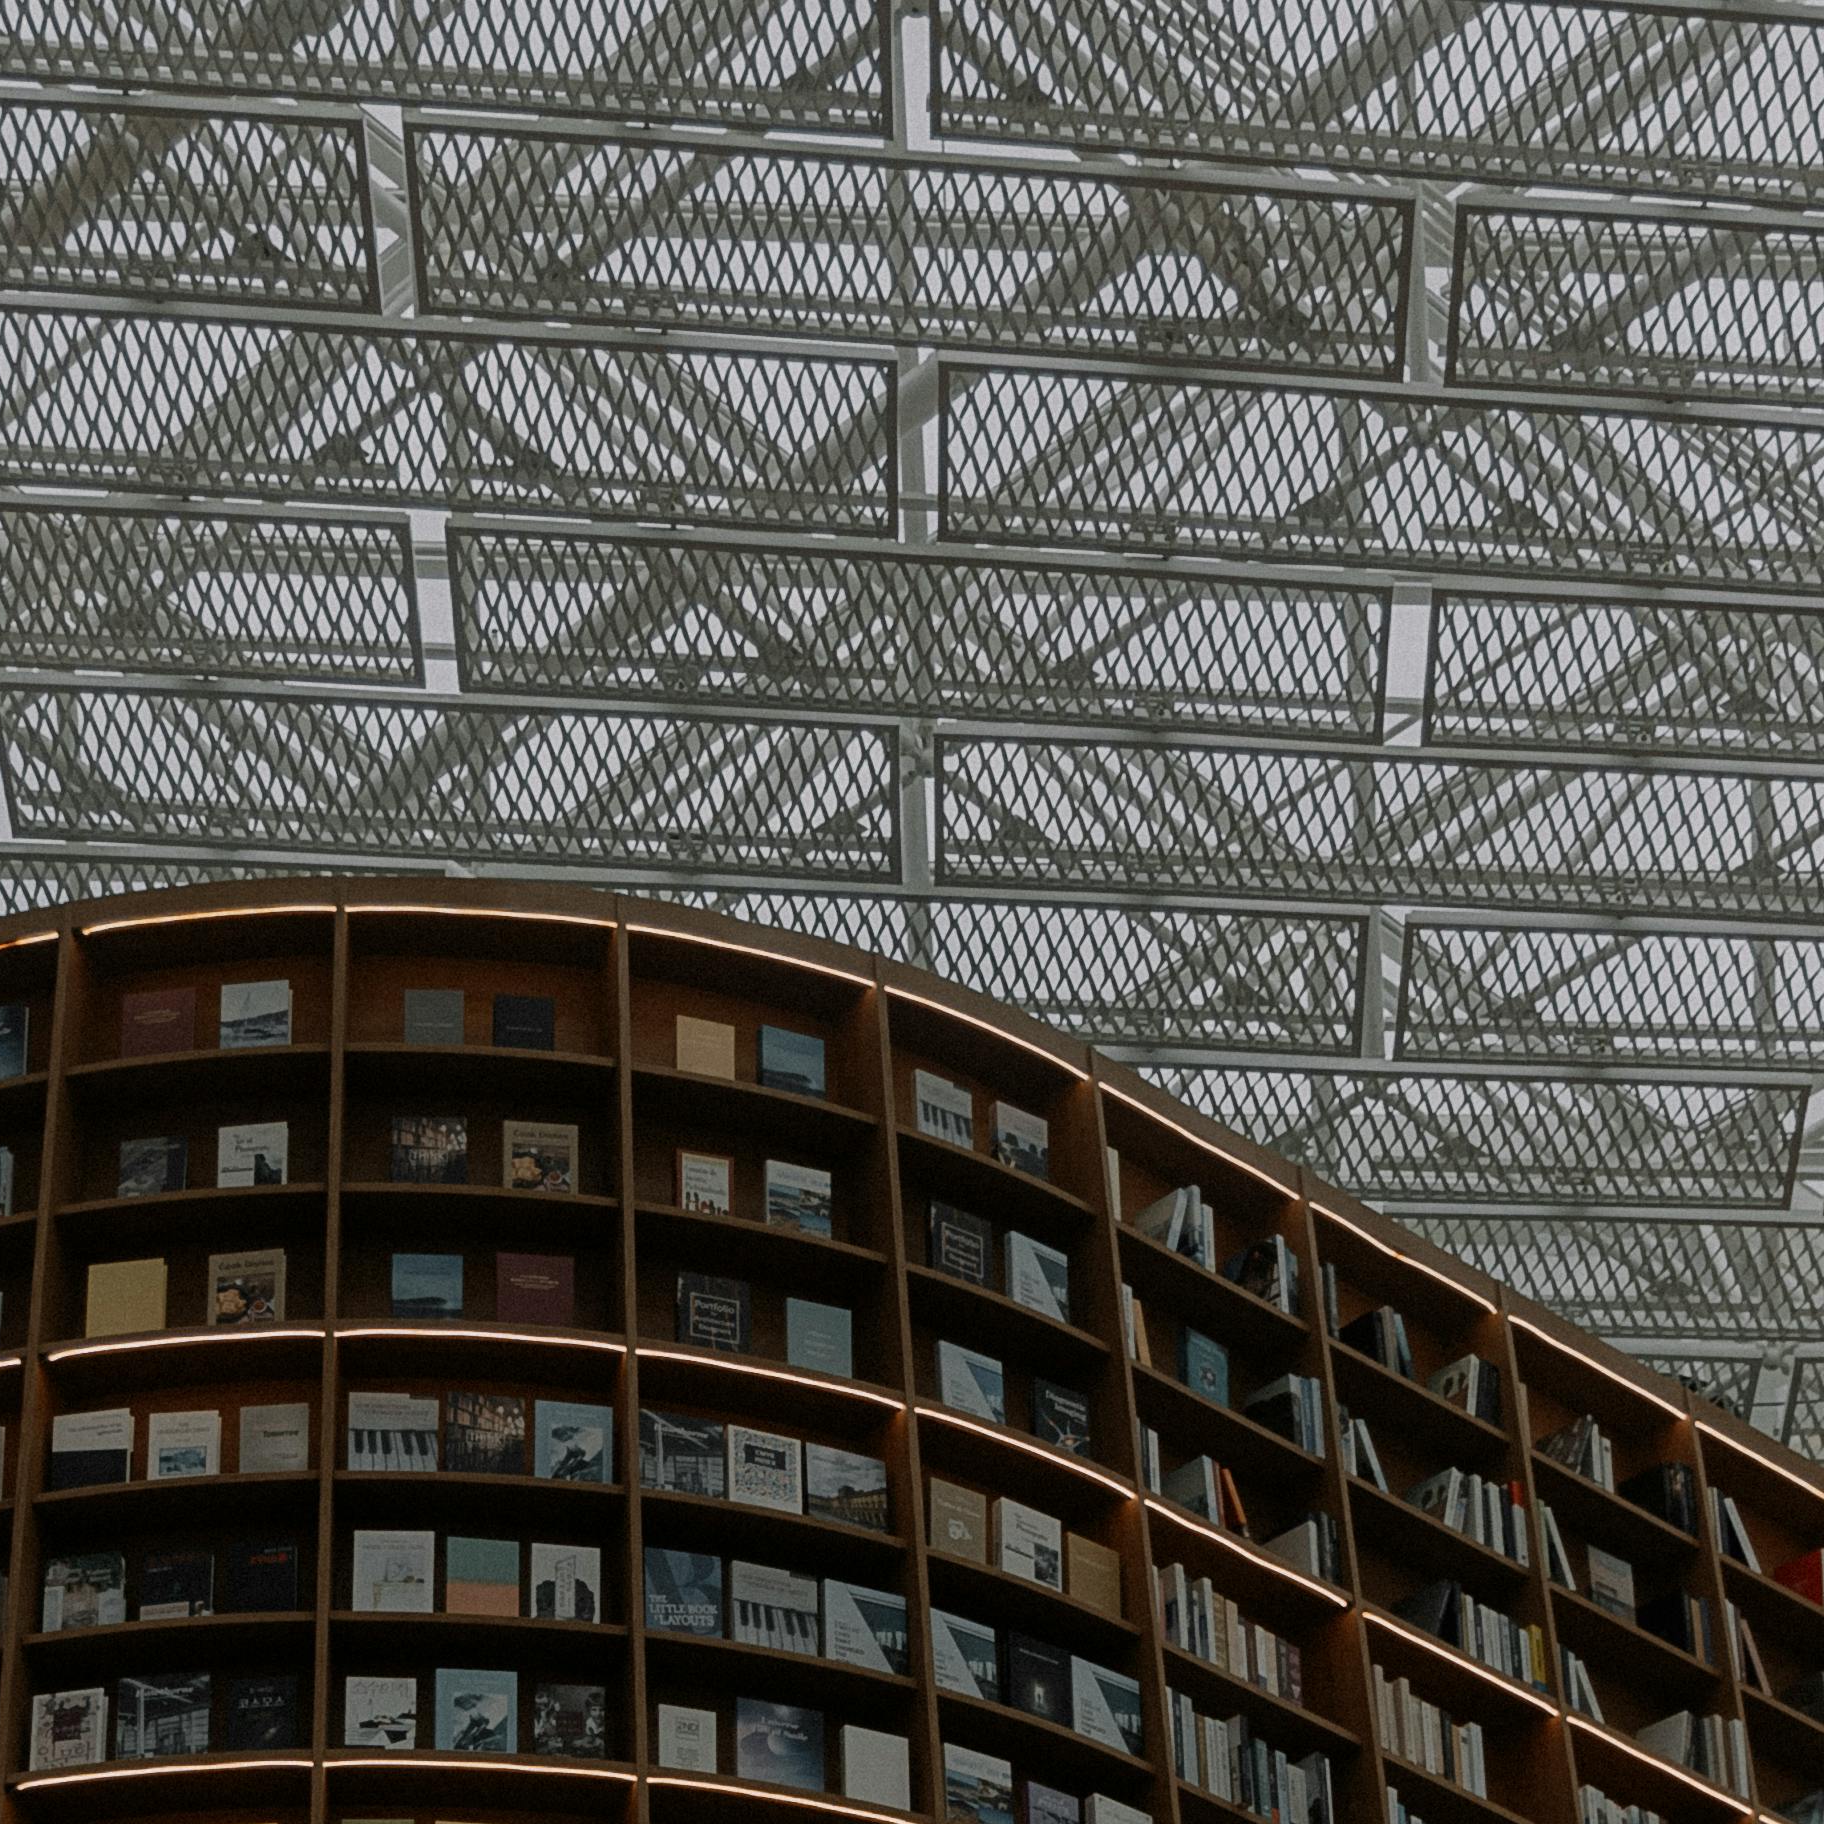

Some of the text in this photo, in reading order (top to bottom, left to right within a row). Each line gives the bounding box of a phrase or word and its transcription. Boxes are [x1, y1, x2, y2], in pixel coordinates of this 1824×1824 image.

[649, 1603, 719, 1616] LITTLE BOOK
[660, 1613, 715, 1628] LAYOUTS
